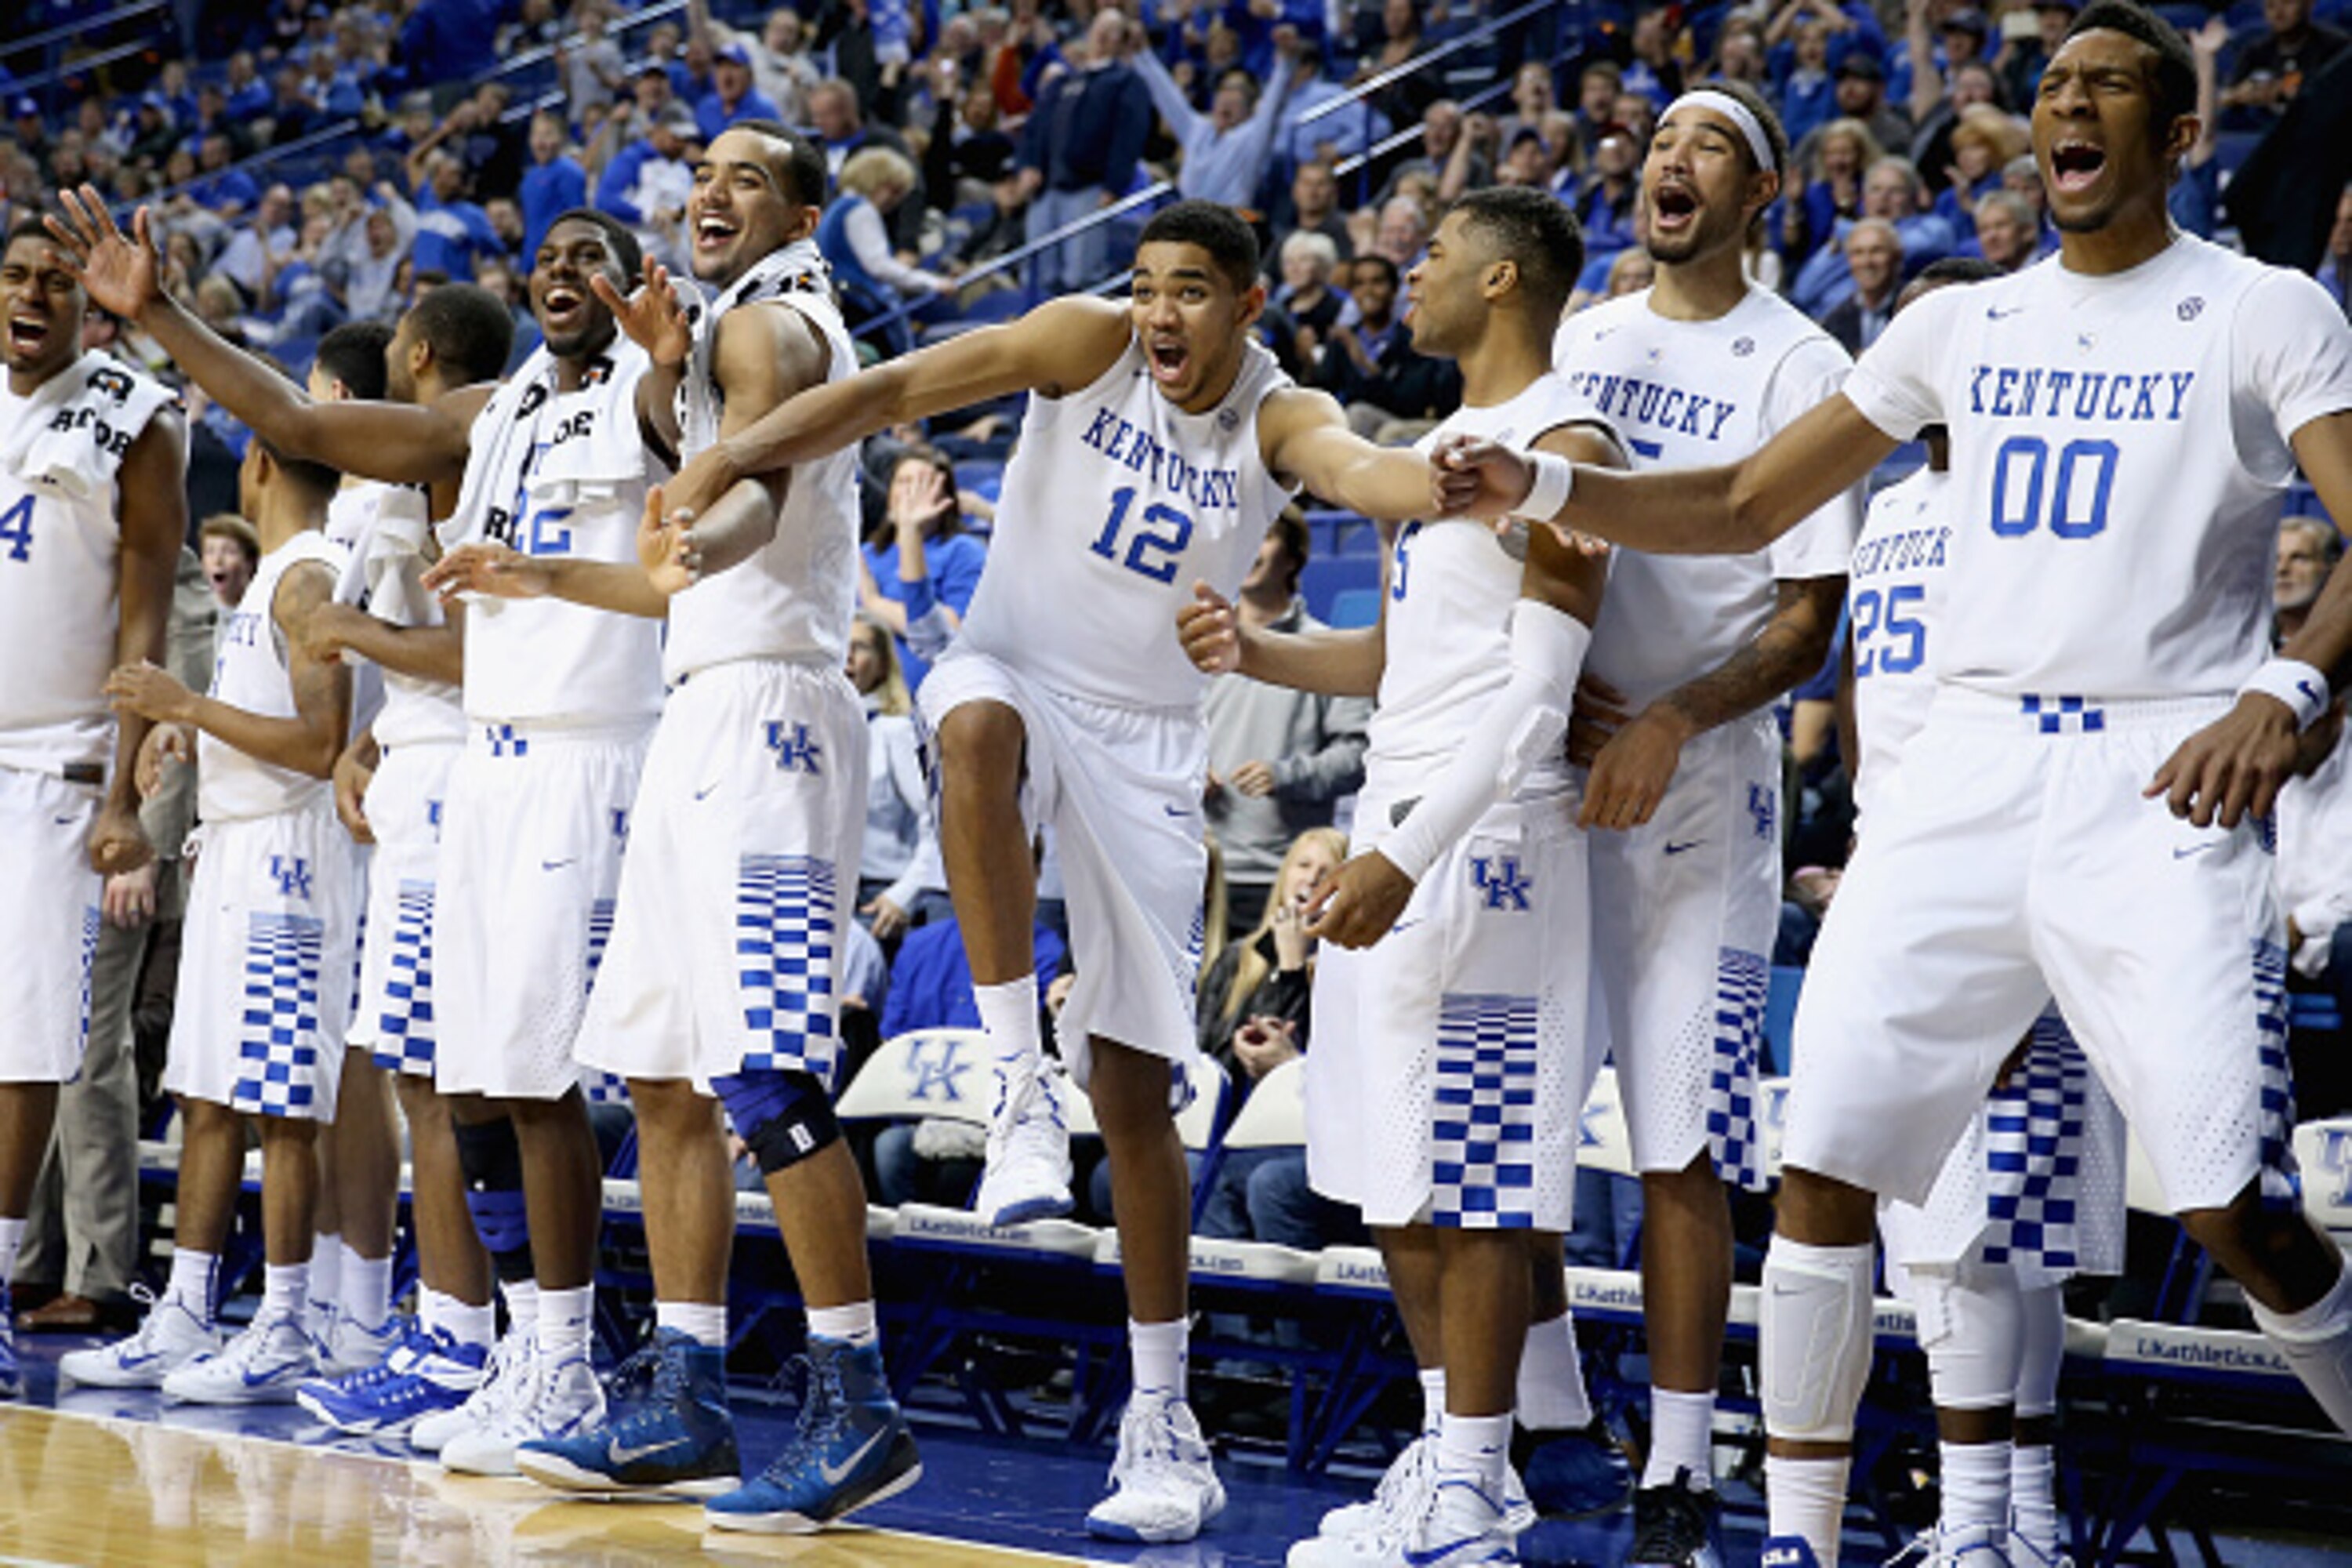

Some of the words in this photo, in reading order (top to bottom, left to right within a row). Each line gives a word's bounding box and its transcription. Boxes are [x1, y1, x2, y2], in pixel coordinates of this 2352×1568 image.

[1969, 365, 2194, 420] KENTUCKY
[1081, 406, 1237, 508] KENTUCKY
[1991, 435, 2119, 539] 00
[1089, 486, 1193, 584] 12
[1853, 585, 1926, 677] 25
[762, 719, 822, 775] UK
[269, 855, 313, 900] UK
[1469, 855, 1533, 911] UK
[904, 1038, 975, 1101] UK
